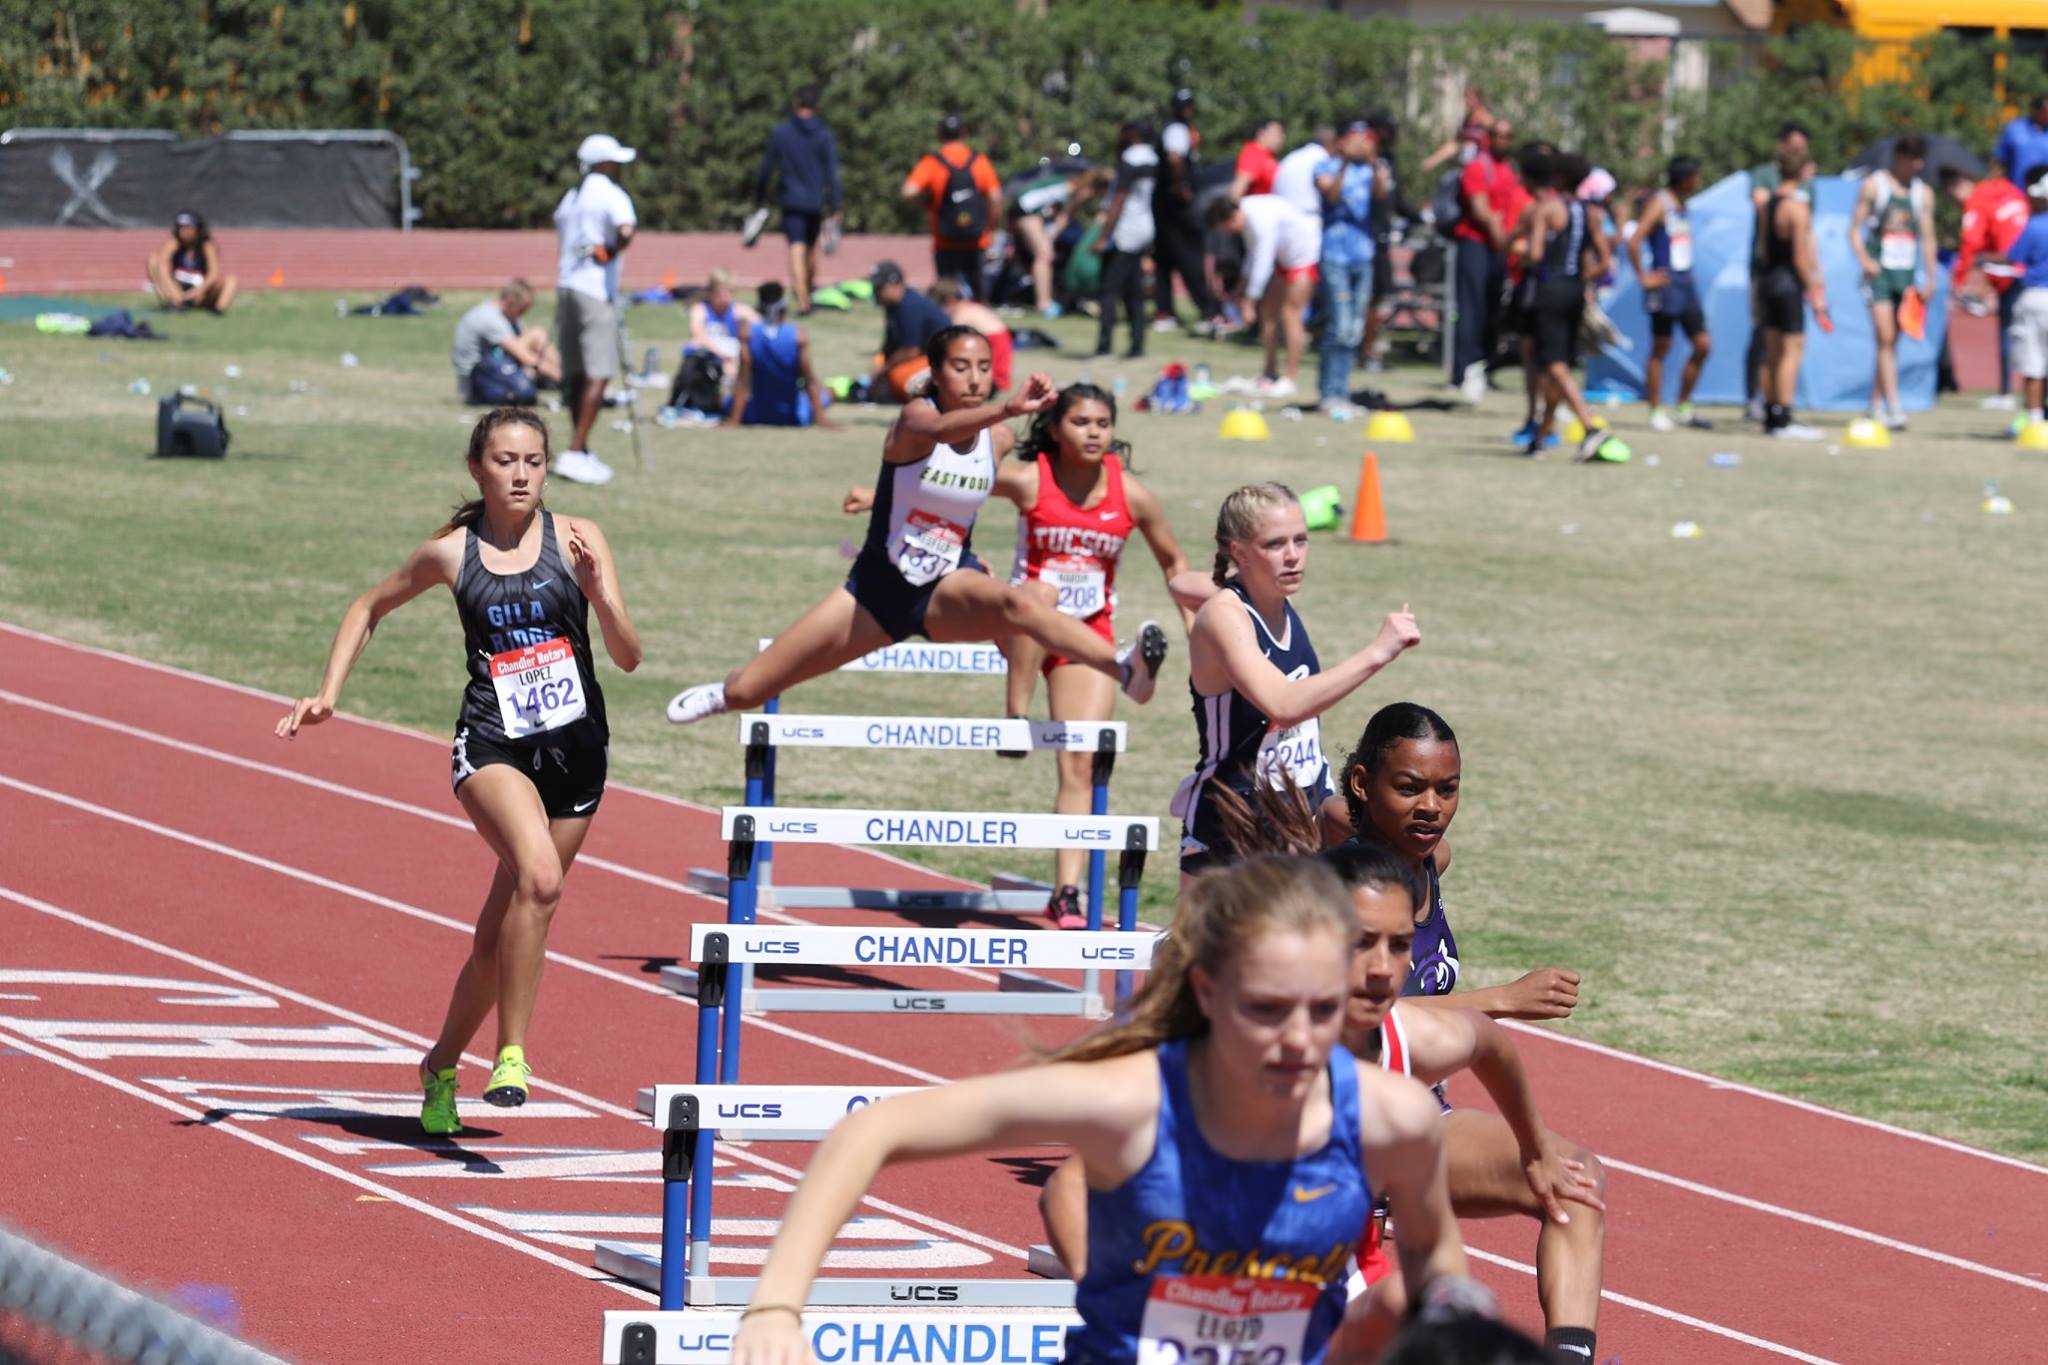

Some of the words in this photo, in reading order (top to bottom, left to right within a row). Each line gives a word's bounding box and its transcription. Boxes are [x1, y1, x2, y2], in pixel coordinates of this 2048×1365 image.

[1034, 527, 1125, 558] TUCSON
[488, 600, 545, 627] GILA
[497, 656, 536, 675] Chandler
[537, 648, 567, 665] Rotary
[863, 648, 1004, 671] CHANDLER
[519, 665, 553, 686] LOPEZ
[507, 677, 578, 719] 1462
[782, 728, 824, 738] UCS
[867, 723, 1001, 746] CHANDLER
[1042, 733, 1083, 743] UCS
[1264, 738, 1317, 773] 2244
[769, 822, 818, 833] UCS
[866, 817, 1017, 845] CHANDLER
[1065, 828, 1112, 840] UCS
[745, 941, 800, 954] UCS
[854, 934, 1028, 965] CHANDLER
[1081, 947, 1136, 960] UCS
[893, 998, 945, 1010] UCS
[718, 1103, 782, 1119] UCS
[891, 1285, 959, 1301] UCS
[679, 1333, 737, 1351] UC
[811, 1322, 1087, 1364] CHANDLE
